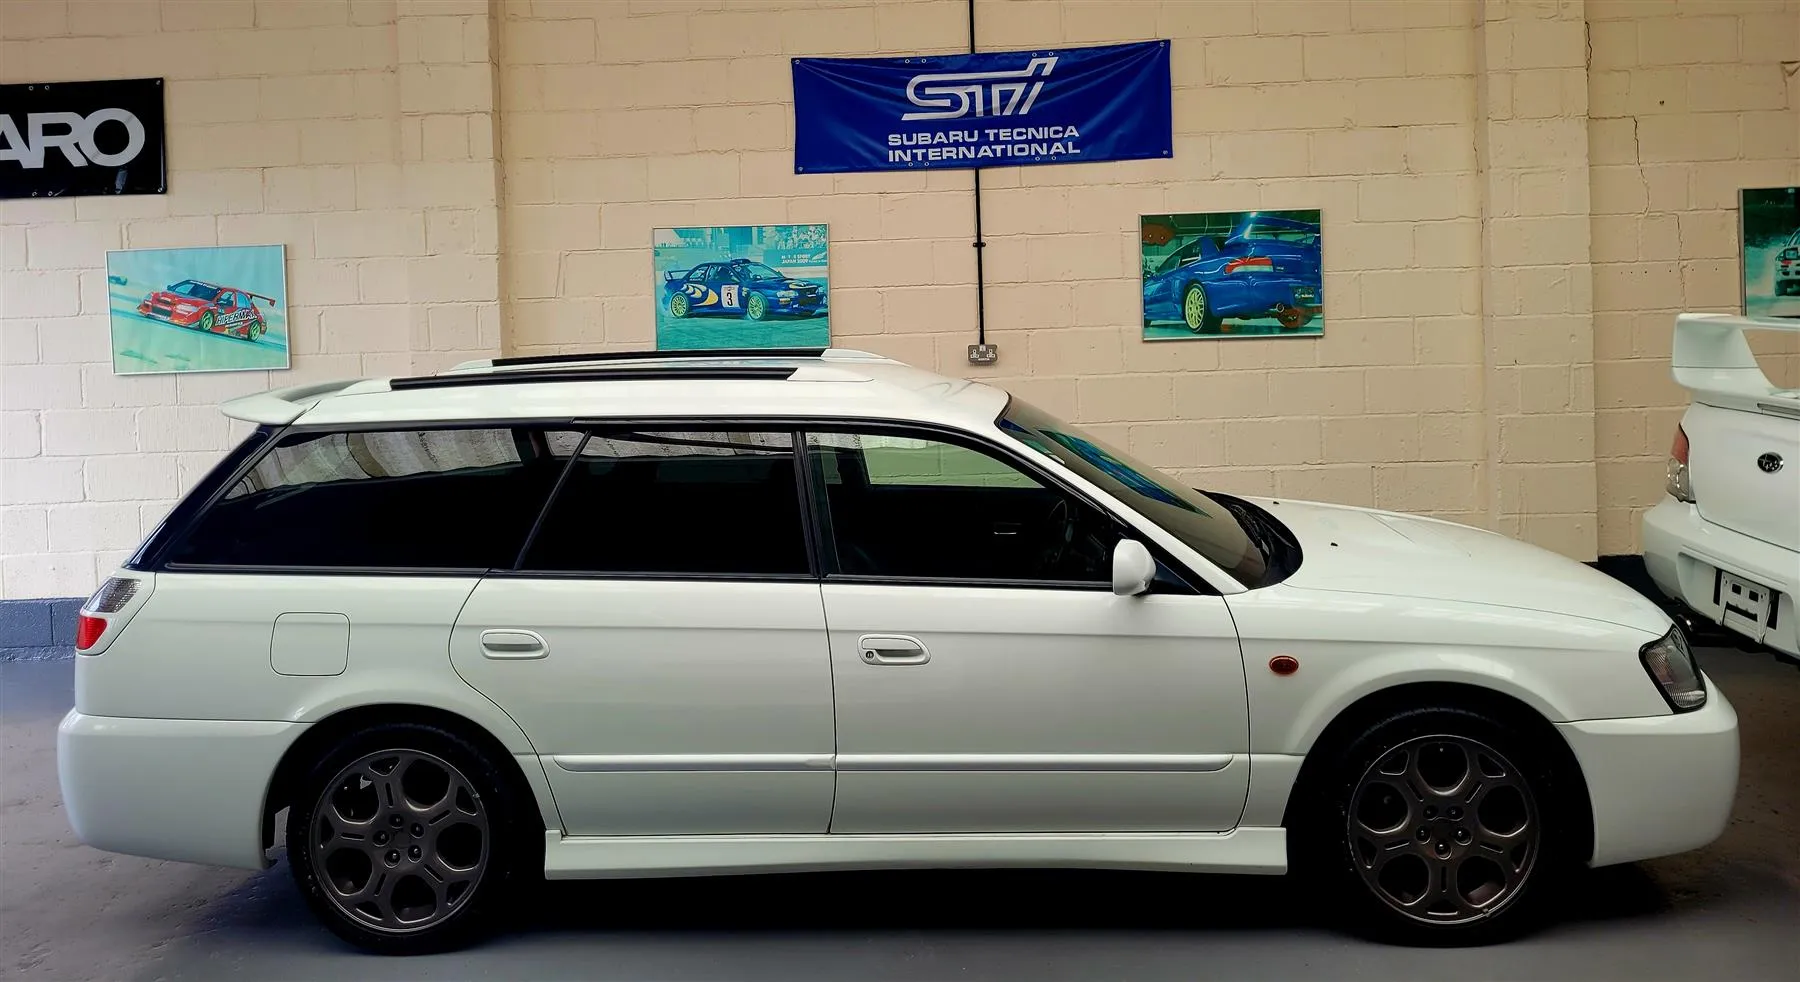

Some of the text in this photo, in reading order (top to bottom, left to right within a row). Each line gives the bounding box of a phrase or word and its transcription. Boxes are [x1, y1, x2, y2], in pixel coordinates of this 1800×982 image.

[888, 125, 1080, 146] SUBARU TECNICA
[888, 141, 1081, 162] INTERNATIONAL
[726, 292, 734, 307] 3
